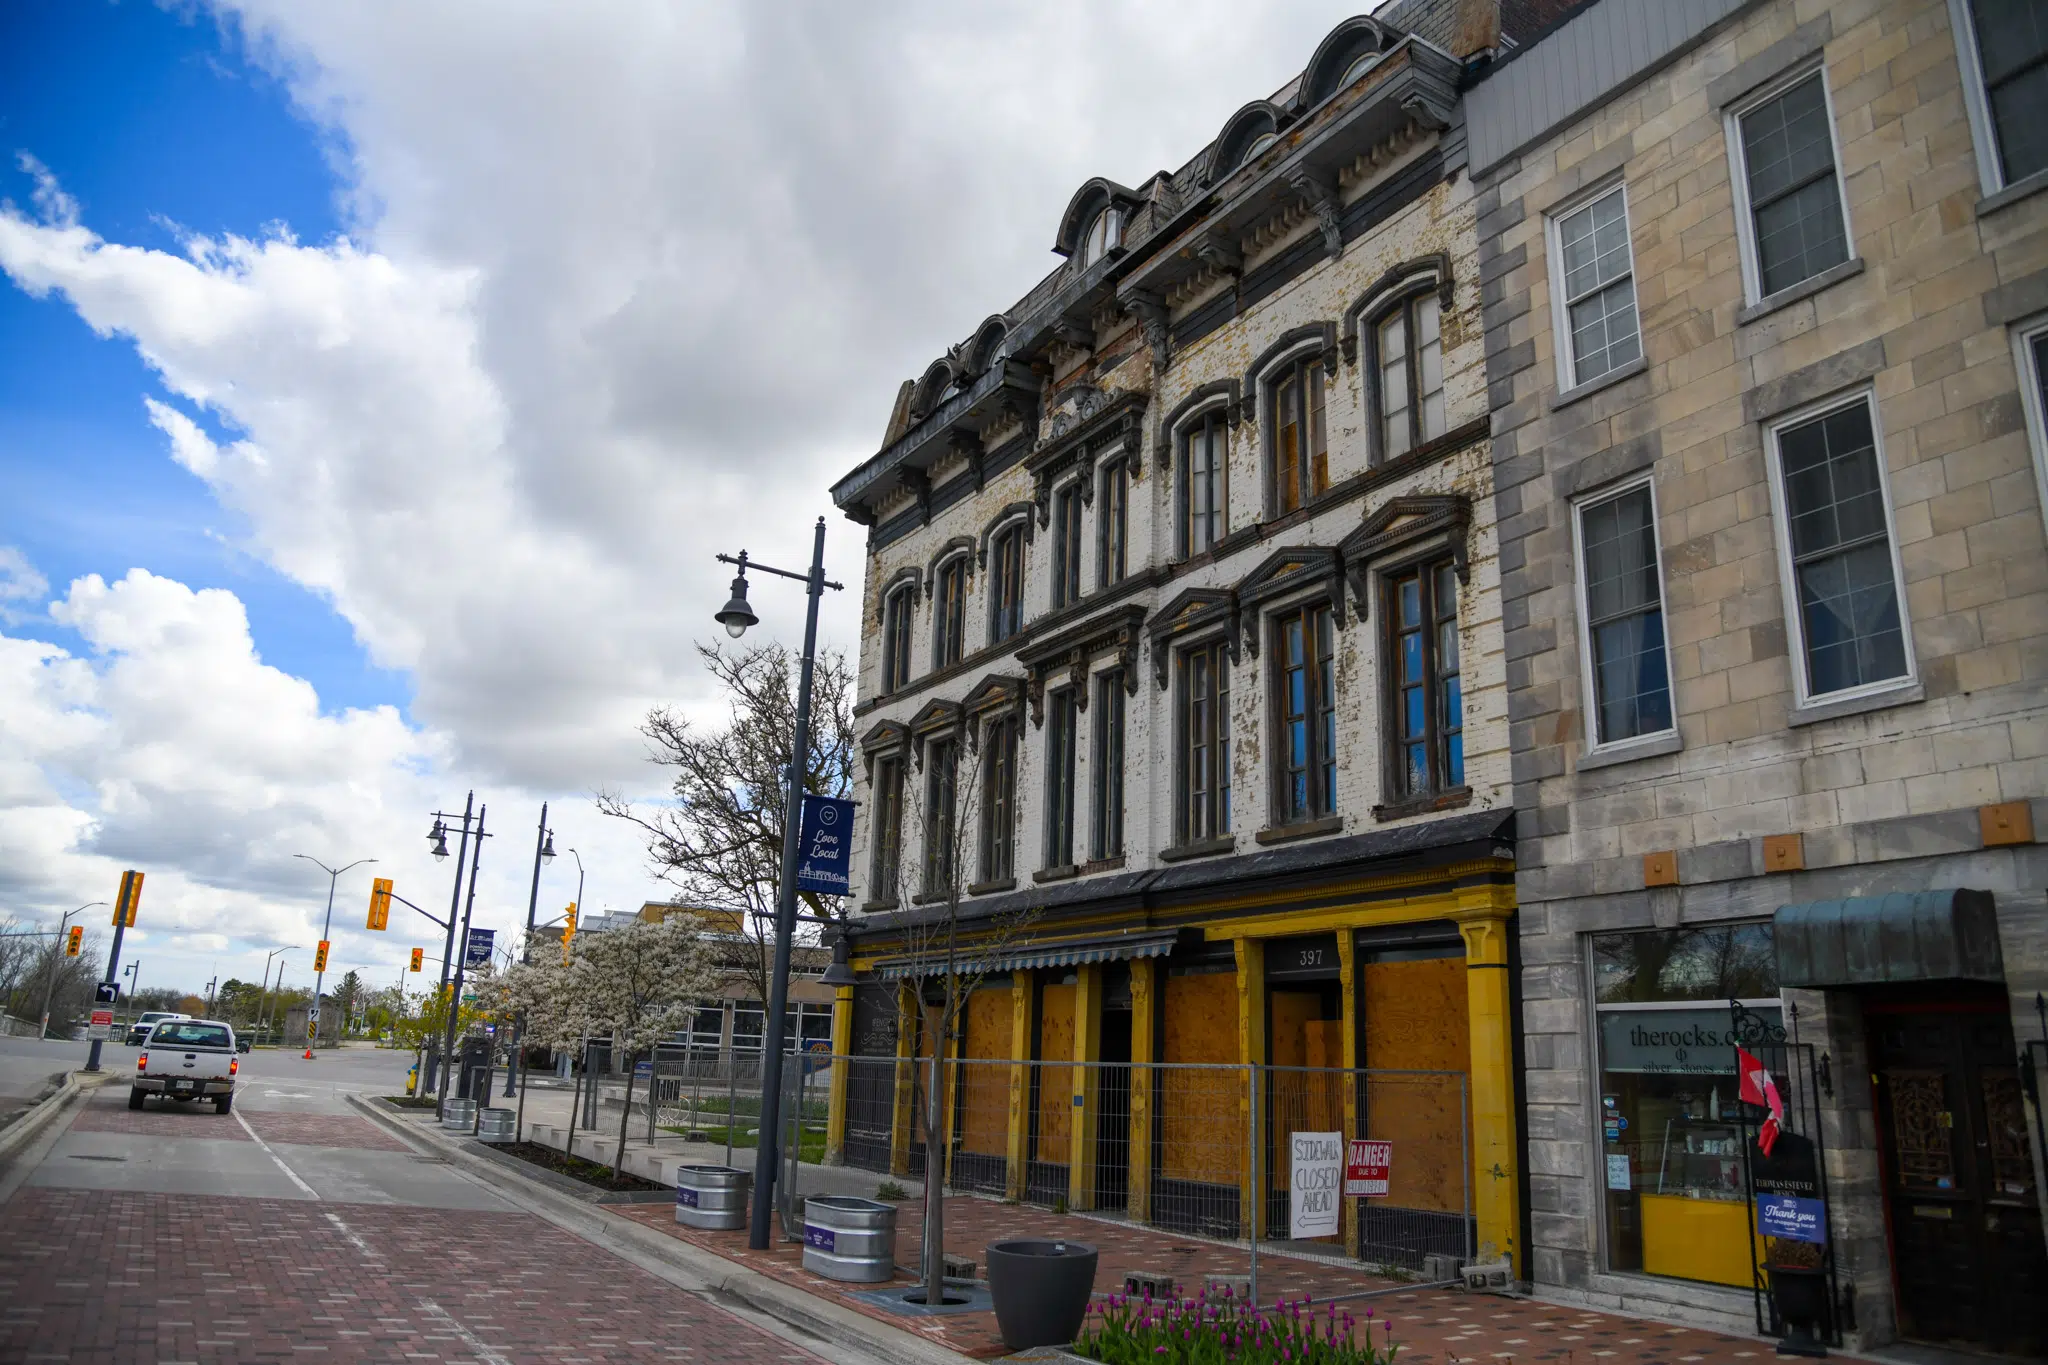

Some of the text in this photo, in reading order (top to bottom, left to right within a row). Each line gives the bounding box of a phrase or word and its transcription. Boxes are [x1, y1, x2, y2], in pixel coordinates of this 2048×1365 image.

[813, 829, 839, 844] Love
[809, 844, 840, 859] Local
[1300, 949, 1322, 966] 397
[1630, 1024, 1746, 1047] therocks.c
[1642, 1061, 1672, 1073] silver
[1680, 1063, 1715, 1074] stones
[1294, 1138, 1339, 1162] SIDEWALK
[1348, 1144, 1390, 1167] DANGER
[1295, 1166, 1339, 1191] CLOSED
[1358, 1168, 1378, 1176] DUE TO
[1756, 1179, 1814, 1191] THOMAS ESTEVEZ
[1773, 1189, 1797, 1197] DESIGN
[1301, 1190, 1333, 1213] AHEAD
[1764, 1204, 1816, 1222] Thank you
[1773, 1219, 1800, 1228] shopping
